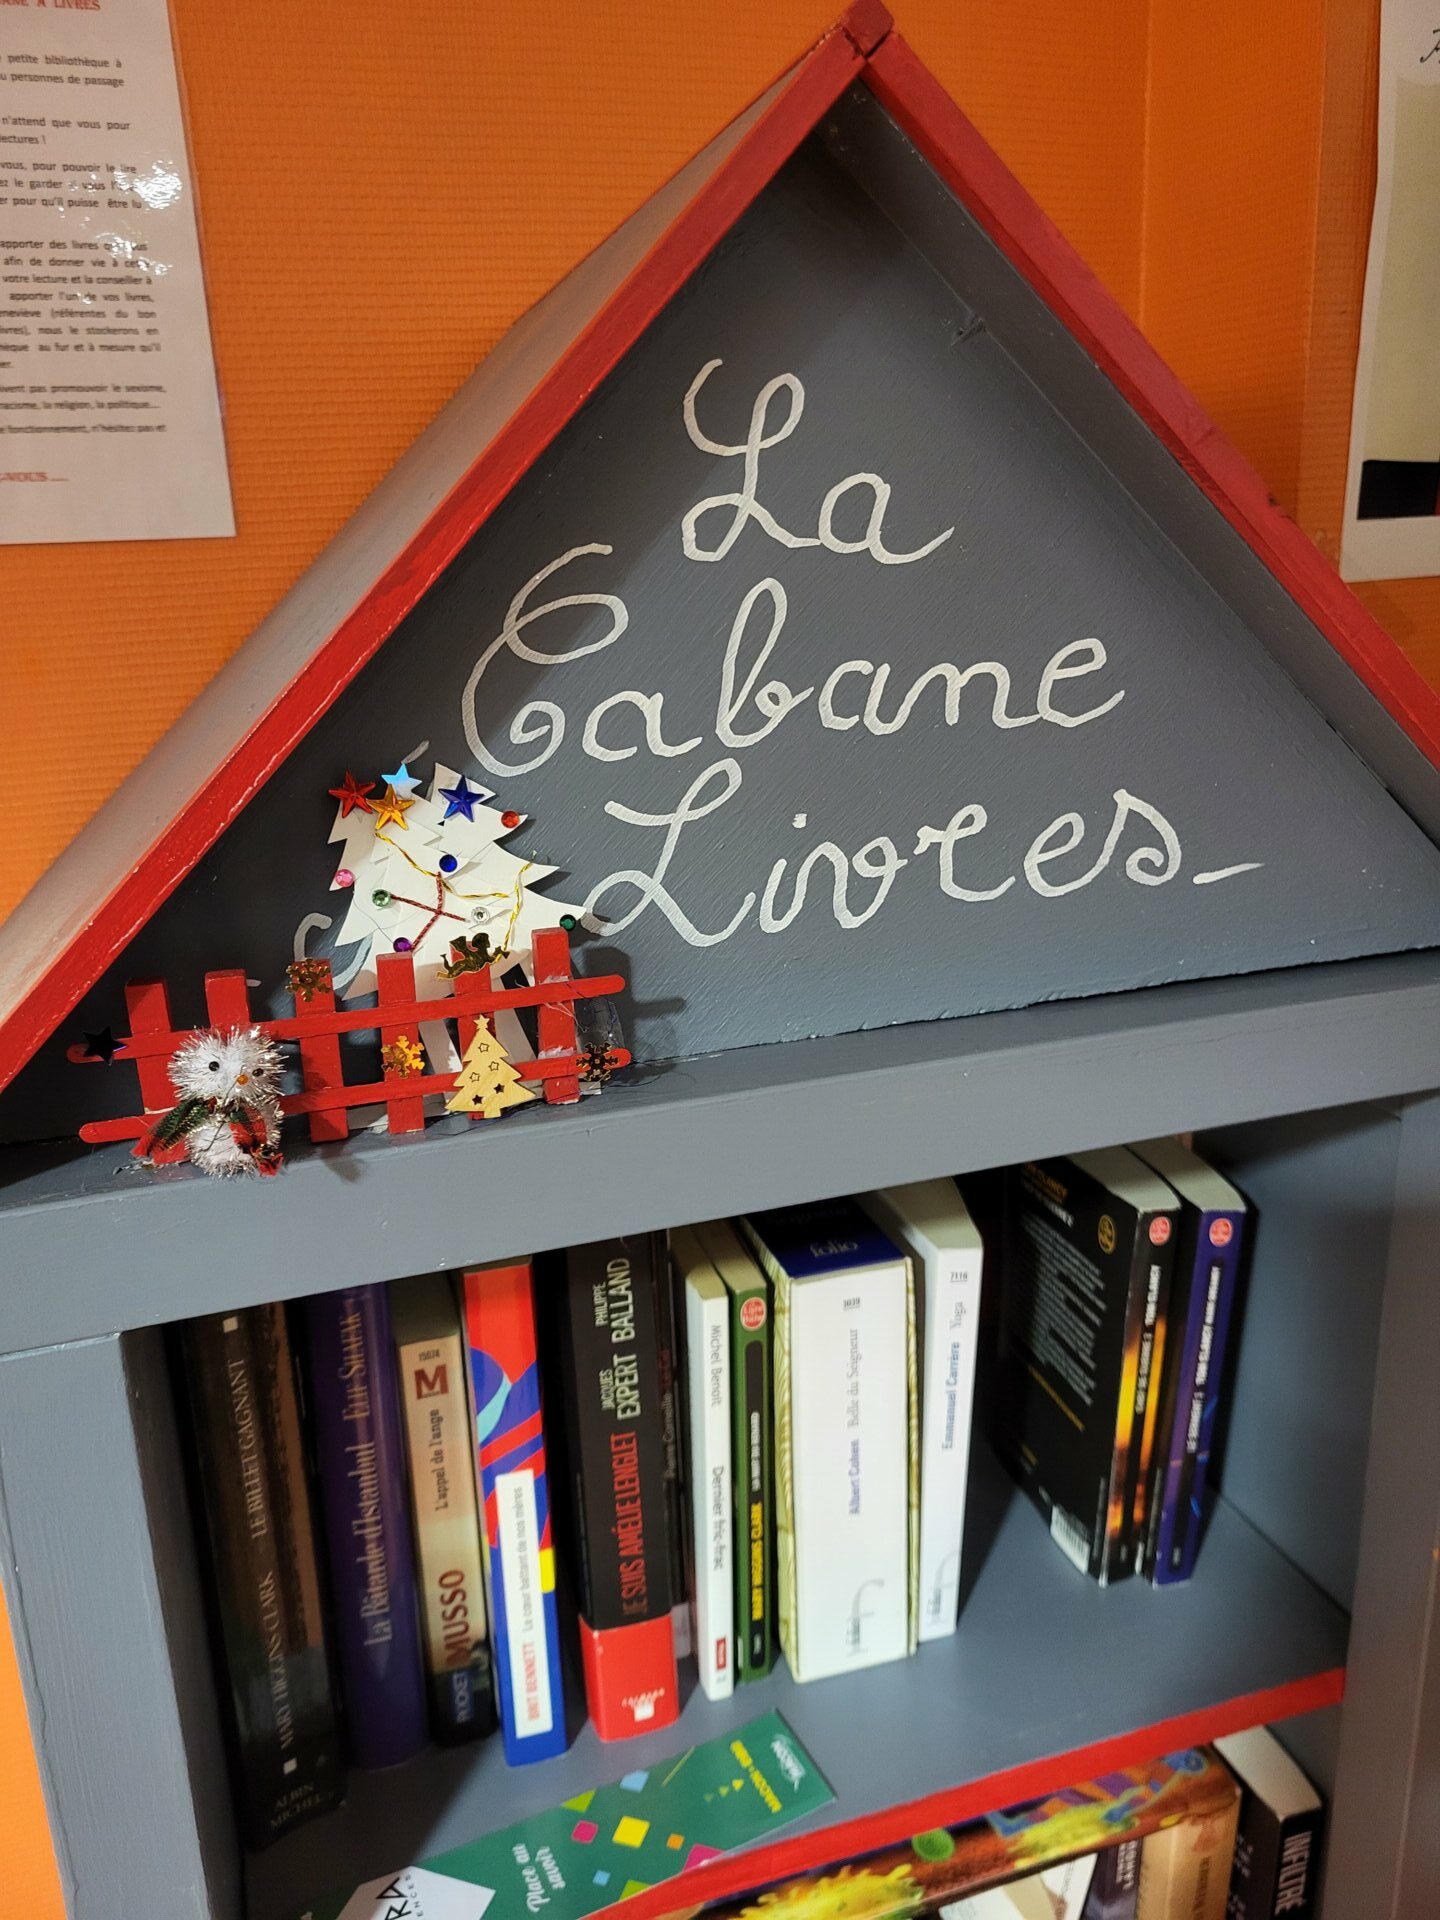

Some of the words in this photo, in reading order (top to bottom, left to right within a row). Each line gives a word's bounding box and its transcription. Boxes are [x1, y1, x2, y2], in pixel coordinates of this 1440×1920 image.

[54, 0, 101, 11] LIVRES
[7, 54, 39, 64] petite
[45, 54, 110, 69] bibliothèque
[10, 73, 64, 83] personnes
[67, 74, 81, 84] de
[85, 76, 125, 88] passage
[2, 117, 46, 127] n'attend
[52, 119, 71, 129] que
[77, 120, 101, 129] vous
[107, 121, 131, 131] pour
[14, 178, 24, 188] le
[29, 179, 62, 190] garder
[82, 182, 105, 191] vous
[32, 162, 56, 173] pour
[62, 163, 101, 173] pouvoir
[106, 163, 115, 173] le
[12, 197, 37, 207] pour
[67, 199, 99, 209] puisse
[107, 198, 128, 209] être
[132, 199, 142, 209] lu
[0, 240, 44, 251] apporter
[50, 240, 67, 250] des
[72, 241, 99, 250] livres
[4, 256, 23, 266] afin
[29, 257, 42, 267] de
[49, 258, 85, 267] donner
[91, 258, 106, 267] vie
[2, 275, 29, 284] votre
[33, 274, 68, 284] lecture
[71, 275, 81, 284] et
[84, 275, 93, 284] la
[96, 275, 143, 285] conseiller
[9, 292, 53, 302] apporter
[102, 293, 120, 301] vos
[38, 327, 63, 335] nous
[69, 326, 79, 335] le
[115, 310, 128, 318] du
[38, 344, 51, 352] au
[681, 357, 956, 565] La
[461, 543, 1126, 778] Cabane
[592, 1281, 608, 1327] PHILIPPE
[606, 1258, 636, 1344] BALLAND
[950, 1301, 966, 1331] Yoga
[710, 1325, 722, 1364] Michel
[847, 1328, 862, 1379] Seigneur
[228, 1358, 257, 1450] GAGNANT
[598, 1368, 615, 1412] JACQUES
[613, 1353, 642, 1421] EXPERT
[711, 1367, 723, 1407] Benoit
[847, 1380, 859, 1396] du
[428, 1409, 444, 1446] l'ange
[847, 1398, 859, 1428] Belle
[942, 1390, 957, 1450] Emmanuel
[431, 1449, 445, 1463] de
[610, 1431, 641, 1501] LENGLET
[849, 1438, 860, 1477] Cohen
[431, 1469, 449, 1512] L'appel
[712, 1466, 725, 1514] Dernier
[849, 1478, 860, 1515] Albert
[250, 1517, 268, 1539] LE
[516, 1537, 527, 1552] de
[611, 1502, 644, 1557] AMÉLIE
[355, 1544, 391, 1617] Bâtarde
[518, 1554, 530, 1591] battant
[619, 1559, 647, 1599] SUIS
[364, 1618, 393, 1646] La
[438, 1569, 474, 1668] MUSSO
[522, 1642, 539, 1694] BENNETT
[527, 1696, 541, 1721] BRIT
[512, 1842, 530, 1864] au
[535, 1845, 566, 1890] savoir
[522, 1865, 551, 1913] Place
